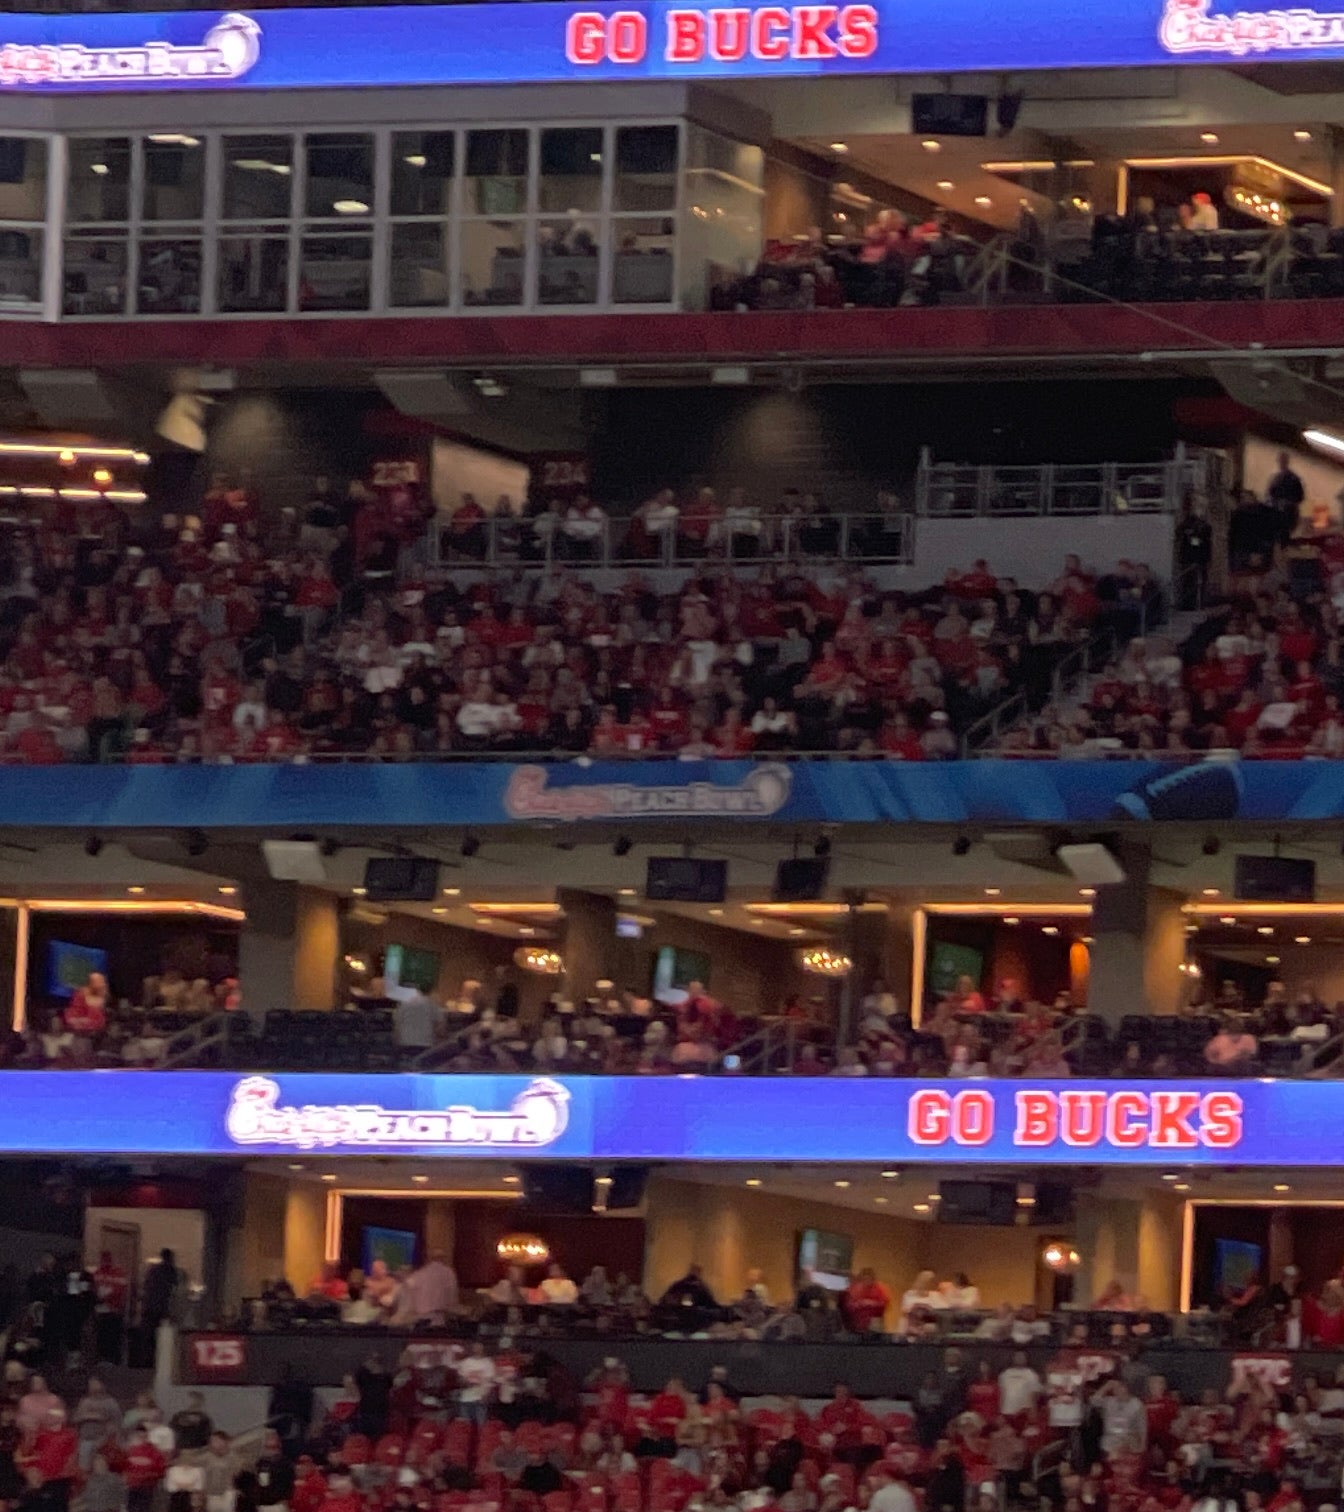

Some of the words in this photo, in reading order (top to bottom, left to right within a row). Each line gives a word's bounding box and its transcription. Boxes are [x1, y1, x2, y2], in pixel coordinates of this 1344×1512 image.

[566, 11, 647, 64] GO
[665, 5, 878, 61] BUCKS
[907, 1089, 996, 1145] GO
[1013, 1090, 1244, 1147] BUCKS
